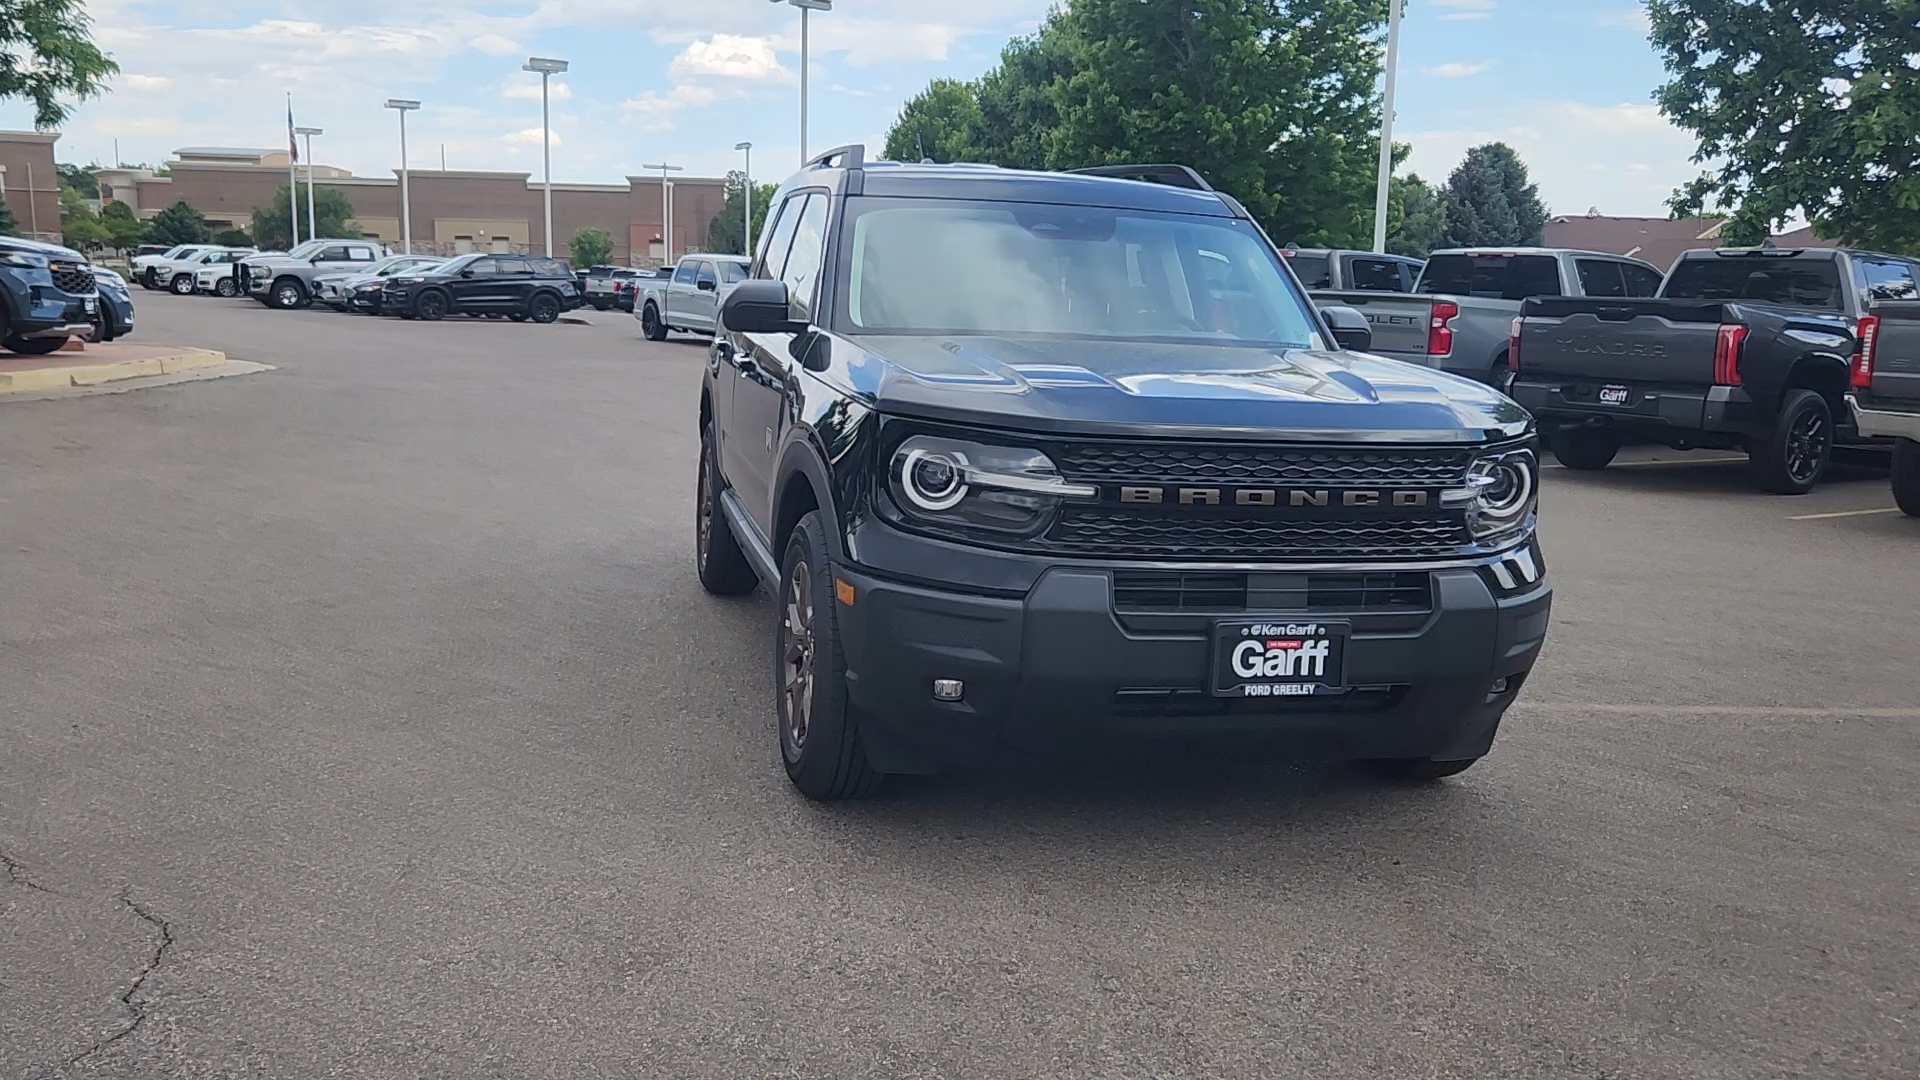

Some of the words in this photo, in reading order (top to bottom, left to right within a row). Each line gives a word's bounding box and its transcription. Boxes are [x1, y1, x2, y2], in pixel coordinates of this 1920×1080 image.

[1600, 389, 1628, 402] Garff
[1120, 486, 1428, 507] BRONCO
[1261, 624, 1286, 636] Ken
[1286, 624, 1317, 636] Garff
[1231, 639, 1330, 678] Garff
[1244, 684, 1271, 696] FORD
[1272, 684, 1316, 696] GREELEY
